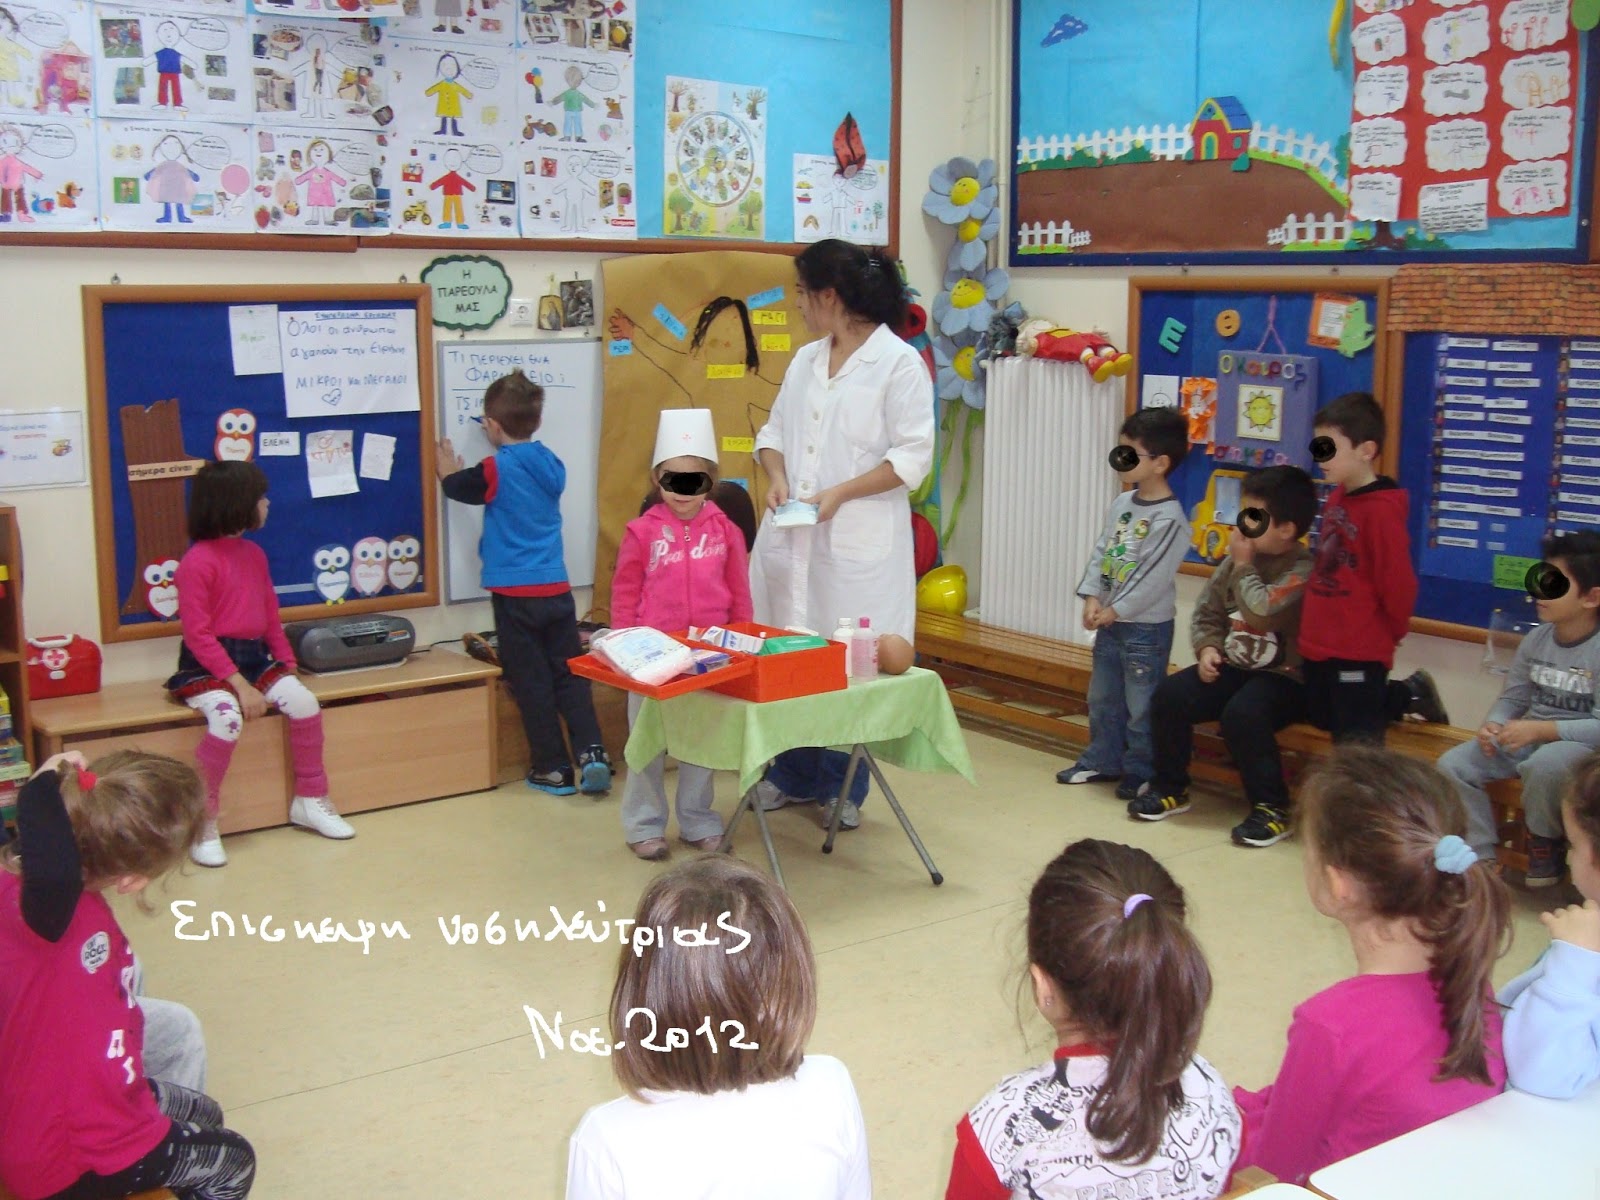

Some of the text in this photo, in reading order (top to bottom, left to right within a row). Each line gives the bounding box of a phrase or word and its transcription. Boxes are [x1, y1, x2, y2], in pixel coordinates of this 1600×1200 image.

[462, 269, 472, 279] Η
[437, 285, 498, 298] ΠΑΡΕΟΥΛΑ
[455, 302, 480, 313] ΜΑΣ
[448, 351, 464, 363] ΤΙ
[263, 438, 290, 447] ΕΛΕΝΗ
